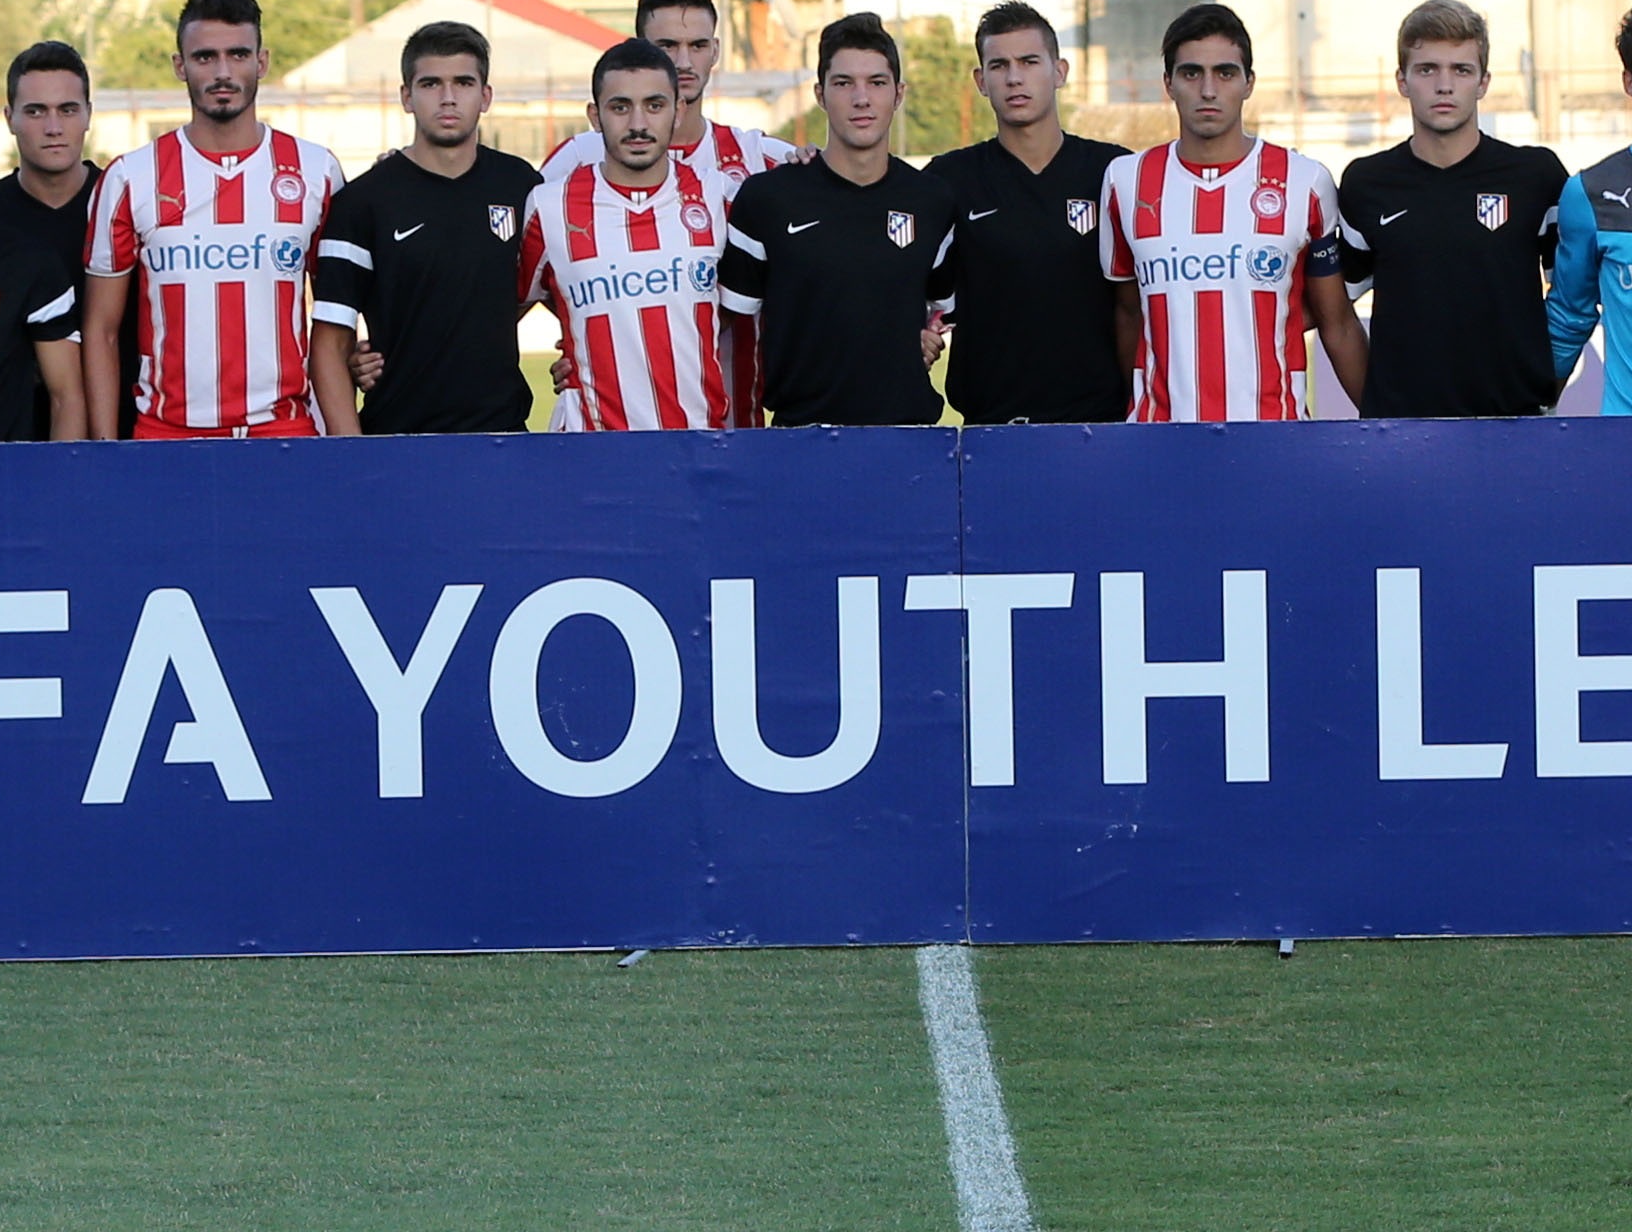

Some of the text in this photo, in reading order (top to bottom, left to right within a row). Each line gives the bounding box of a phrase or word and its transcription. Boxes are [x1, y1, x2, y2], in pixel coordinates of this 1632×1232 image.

[147, 233, 267, 273] unicef
[1135, 244, 1242, 288] unicef
[568, 257, 683, 309] unicef
[308, 573, 1270, 800] YOUTH
